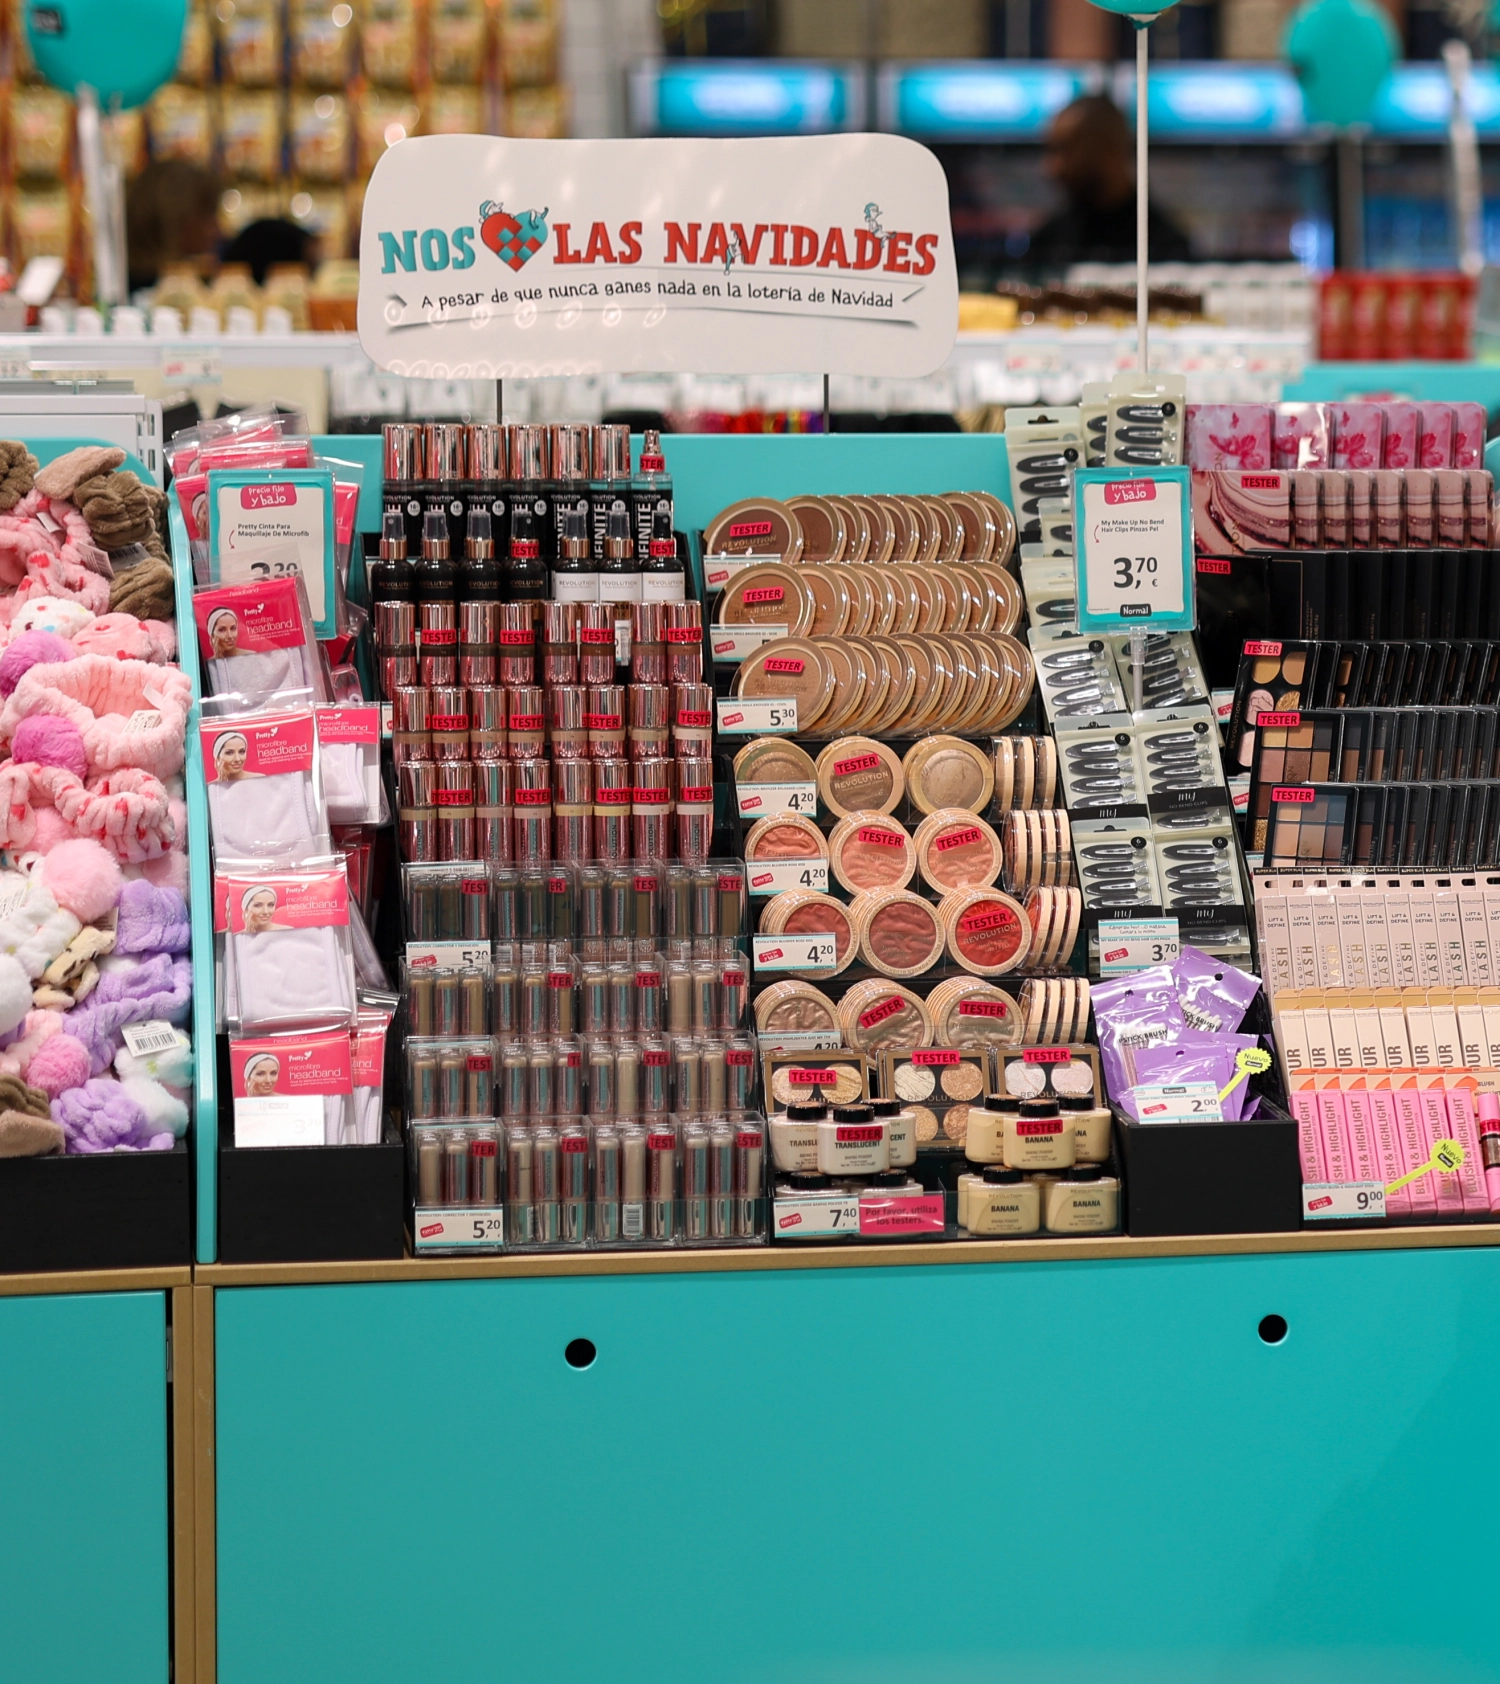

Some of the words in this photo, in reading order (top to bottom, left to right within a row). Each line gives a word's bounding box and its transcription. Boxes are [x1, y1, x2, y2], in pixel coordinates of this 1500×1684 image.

[378, 226, 476, 274] NOS
[553, 222, 643, 265] LAS
[664, 221, 939, 276] NAVIDADES
[421, 296, 434, 309] A
[438, 292, 485, 312] pesar
[491, 287, 509, 304] de
[514, 285, 544, 305] que
[548, 284, 598, 299] nunca
[605, 279, 652, 296] ganes
[658, 279, 697, 295] nada
[702, 283, 722, 297] en
[727, 281, 742, 298] la
[747, 282, 802, 302] lotería
[808, 287, 826, 304] de
[832, 289, 894, 309] Navidad
[1244, 477, 1278, 488] TESTER
[248, 486, 272, 496] Precio
[272, 485, 285, 495] fijo
[1114, 494, 1121, 502] y
[1122, 488, 1146, 501] bajo
[251, 497, 259, 507] y
[260, 493, 287, 506] bajo
[733, 524, 770, 535] TESTER
[1199, 562, 1229, 572] TESTER
[746, 589, 781, 601] TESTER
[244, 608, 258, 617] Pretty
[1123, 606, 1149, 616] Normal
[246, 619, 293, 635] headband
[1247, 644, 1280, 654] TESTER
[767, 660, 801, 671] TESTER
[433, 718, 468, 728] TESTER
[1260, 715, 1298, 725] TESTER
[319, 724, 368, 732] headband
[255, 731, 271, 740] Pretty
[256, 740, 287, 749] microfibre
[257, 743, 307, 758] headband
[837, 756, 877, 773] TESTER
[834, 770, 889, 790] REVOLUTION
[437, 792, 471, 802] TESTER
[1276, 790, 1312, 801] TESTER
[862, 831, 902, 846] TESTER
[939, 831, 980, 849] TESTER
[286, 899, 338, 910] headband
[967, 912, 1007, 930] TESTER
[963, 922, 1017, 945] REVOLUTION
[1302, 945, 1314, 986] LASH
[1376, 943, 1389, 984] LASH
[1401, 942, 1413, 982] LASH
[1425, 942, 1438, 981] LASH
[1475, 940, 1489, 979] LASH
[1277, 947, 1289, 988] LASH
[863, 1000, 902, 1025] TESTER
[963, 1003, 1005, 1016] TESTER
[915, 1053, 957, 1064] TESTER
[1026, 1051, 1068, 1061] TESTER
[289, 1068, 341, 1079] headband
[792, 1072, 834, 1082] TESTER
[1019, 1123, 1061, 1134] TESTER
[1299, 1101, 1314, 1153] HIGHLIGHT
[1324, 1100, 1340, 1152] HIGHLIGHT
[1351, 1100, 1367, 1151] HIGHLIGHT
[1375, 1100, 1392, 1150] HIGHLIGHT
[1401, 1099, 1417, 1149] HIGHLIGHT
[1453, 1098, 1470, 1151] HIGHLIGHT
[840, 1129, 881, 1140] TESTER
[1025, 1136, 1053, 1144] BANANA
[835, 1141, 880, 1149] TRANSLUCENT
[1441, 1143, 1461, 1164] Nuevo
[1464, 1160, 1478, 1193] BLUSH
[991, 1205, 1020, 1213] BANANA
[1073, 1200, 1101, 1208] BANANA
[866, 1208, 881, 1216] Por
[883, 1207, 909, 1216] favor,
[911, 1206, 938, 1214] utiliza
[877, 1217, 889, 1225] los
[892, 1216, 925, 1225] testers.
